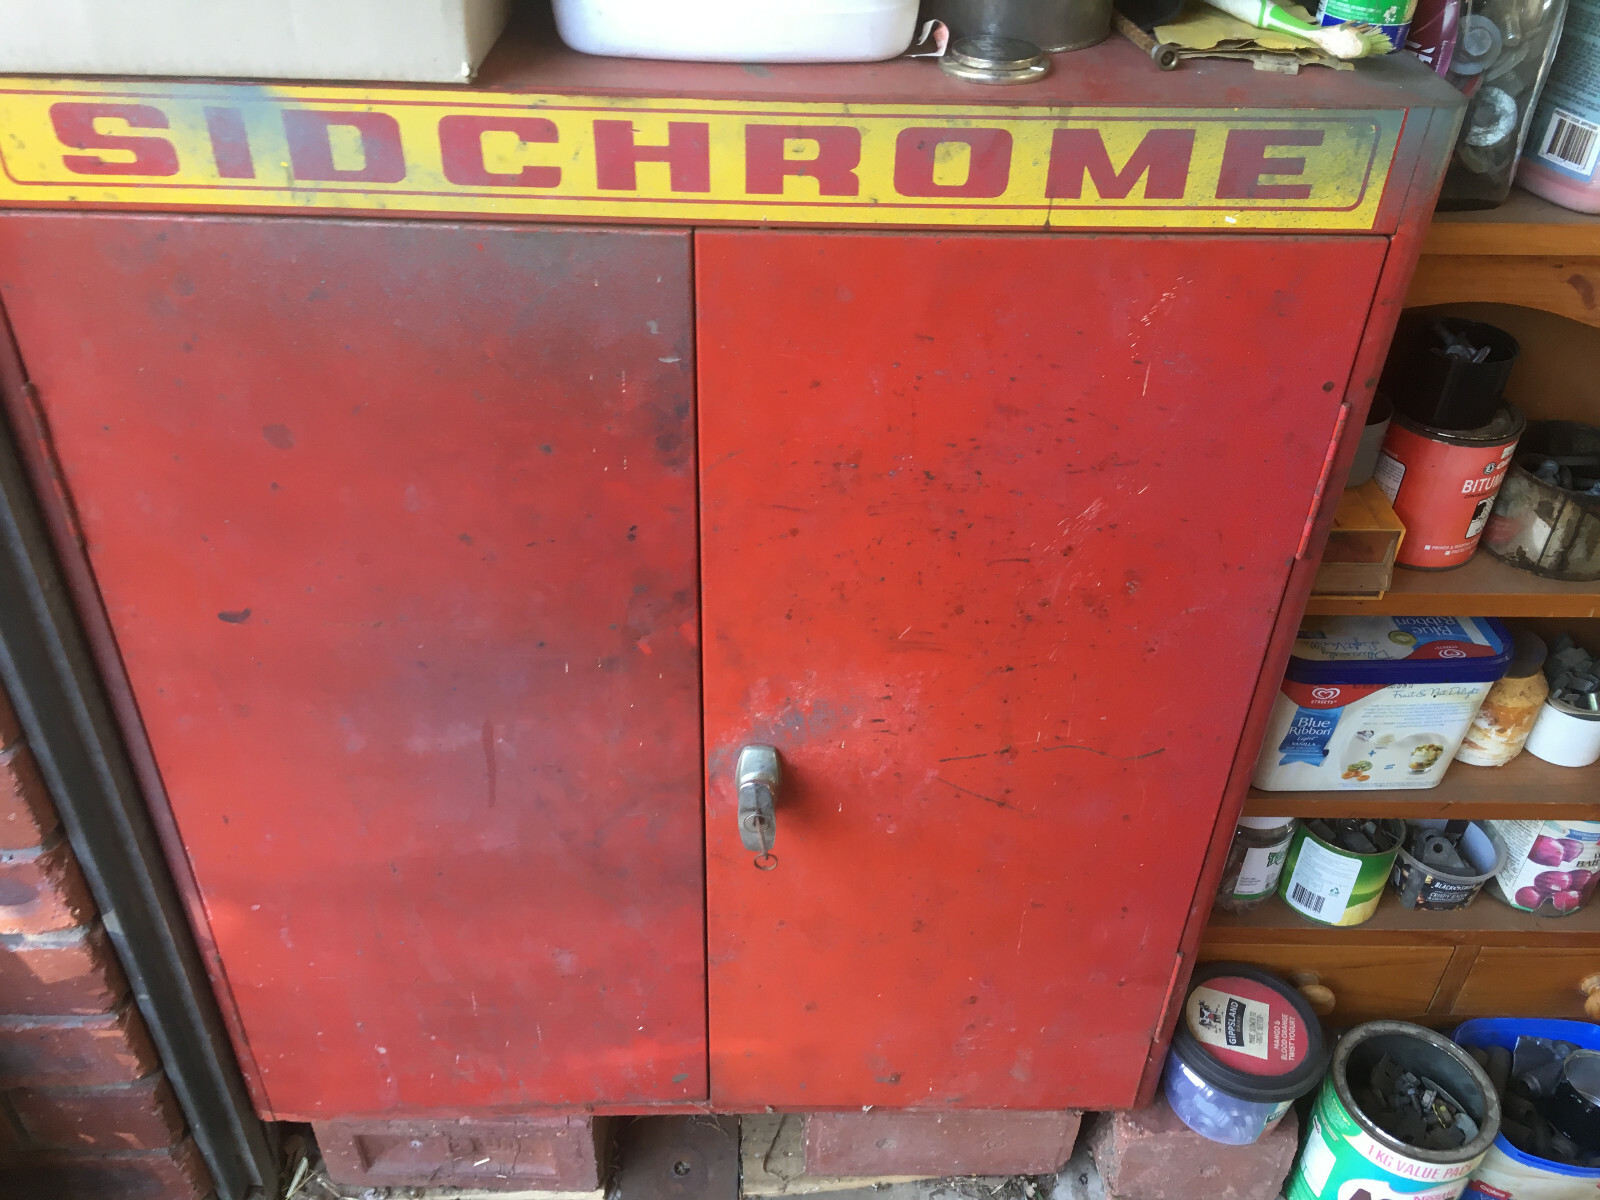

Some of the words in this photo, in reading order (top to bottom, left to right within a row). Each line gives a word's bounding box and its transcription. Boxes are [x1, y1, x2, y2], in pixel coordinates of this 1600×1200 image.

[49, 101, 1325, 199] SIDCHROME
[1412, 625, 1453, 636] Blue
[1393, 689, 1415, 699] Fruit
[1289, 727, 1332, 736] Ribbon
[1297, 717, 1331, 728] Blue
[1228, 1001, 1238, 1044] GIPPSLAND
[1281, 1013, 1289, 1039] ORANGE
[1288, 1015, 1296, 1041] YOGURT
[1288, 1041, 1296, 1061] TWIST
[1368, 1144, 1375, 1155] 1
[1375, 1150, 1394, 1167] KG
[1396, 1160, 1440, 1180] VALUE
[1480, 1184, 1506, 1198] coles
